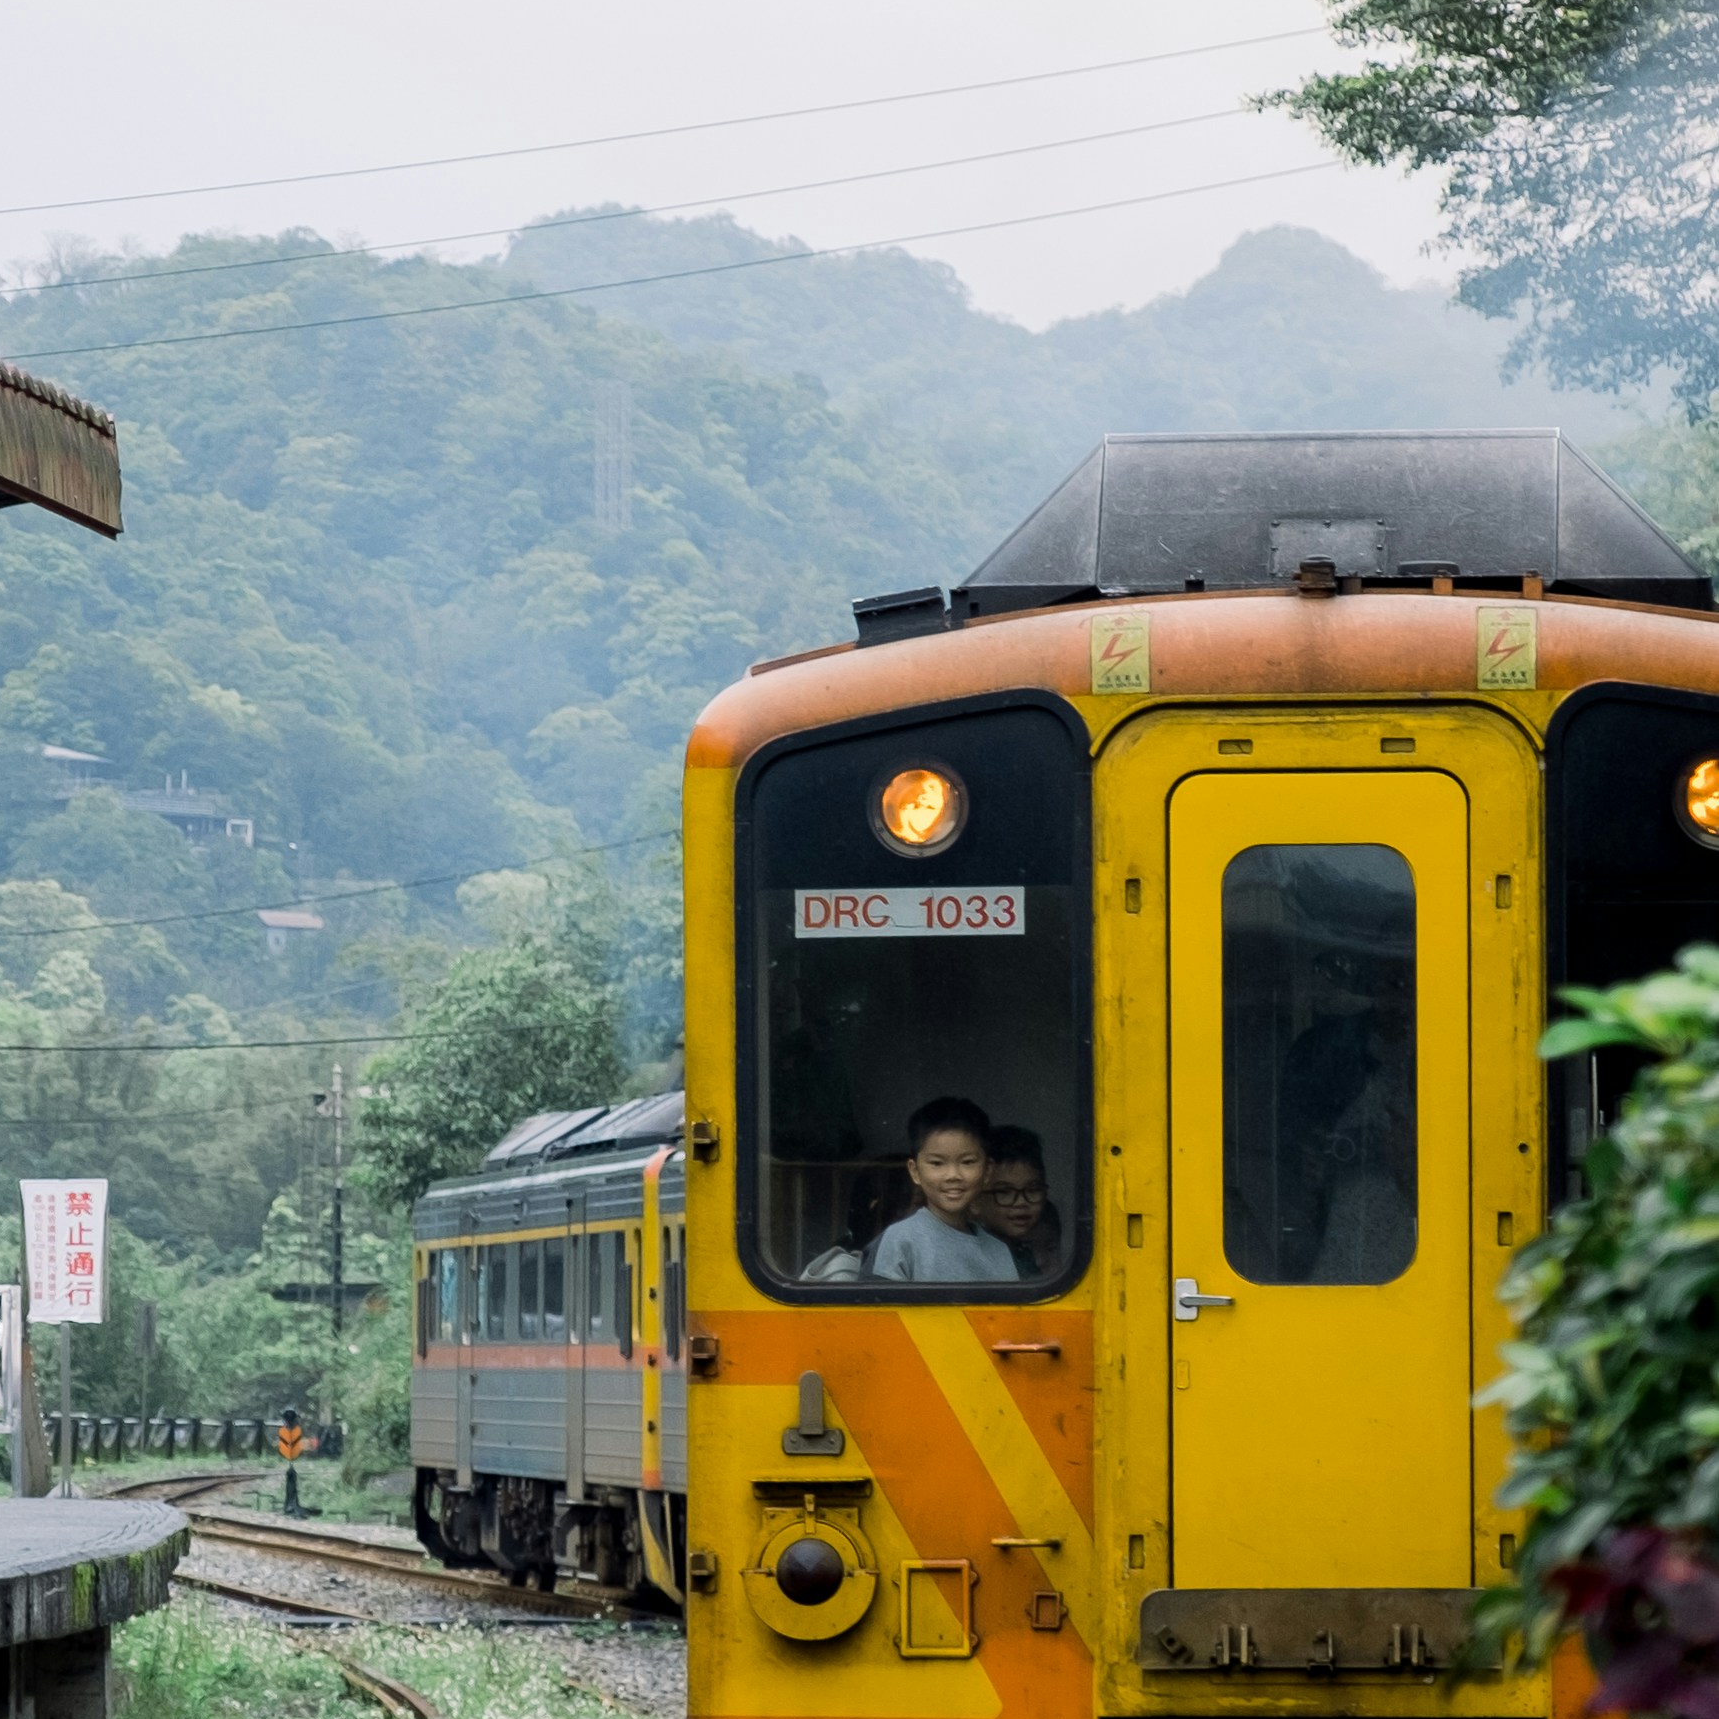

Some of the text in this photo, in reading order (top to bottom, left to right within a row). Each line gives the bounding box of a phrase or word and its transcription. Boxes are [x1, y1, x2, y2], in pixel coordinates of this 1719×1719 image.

[803, 894, 1017, 929] DRC 1033
[65, 1191, 94, 1306] 禁止通行
